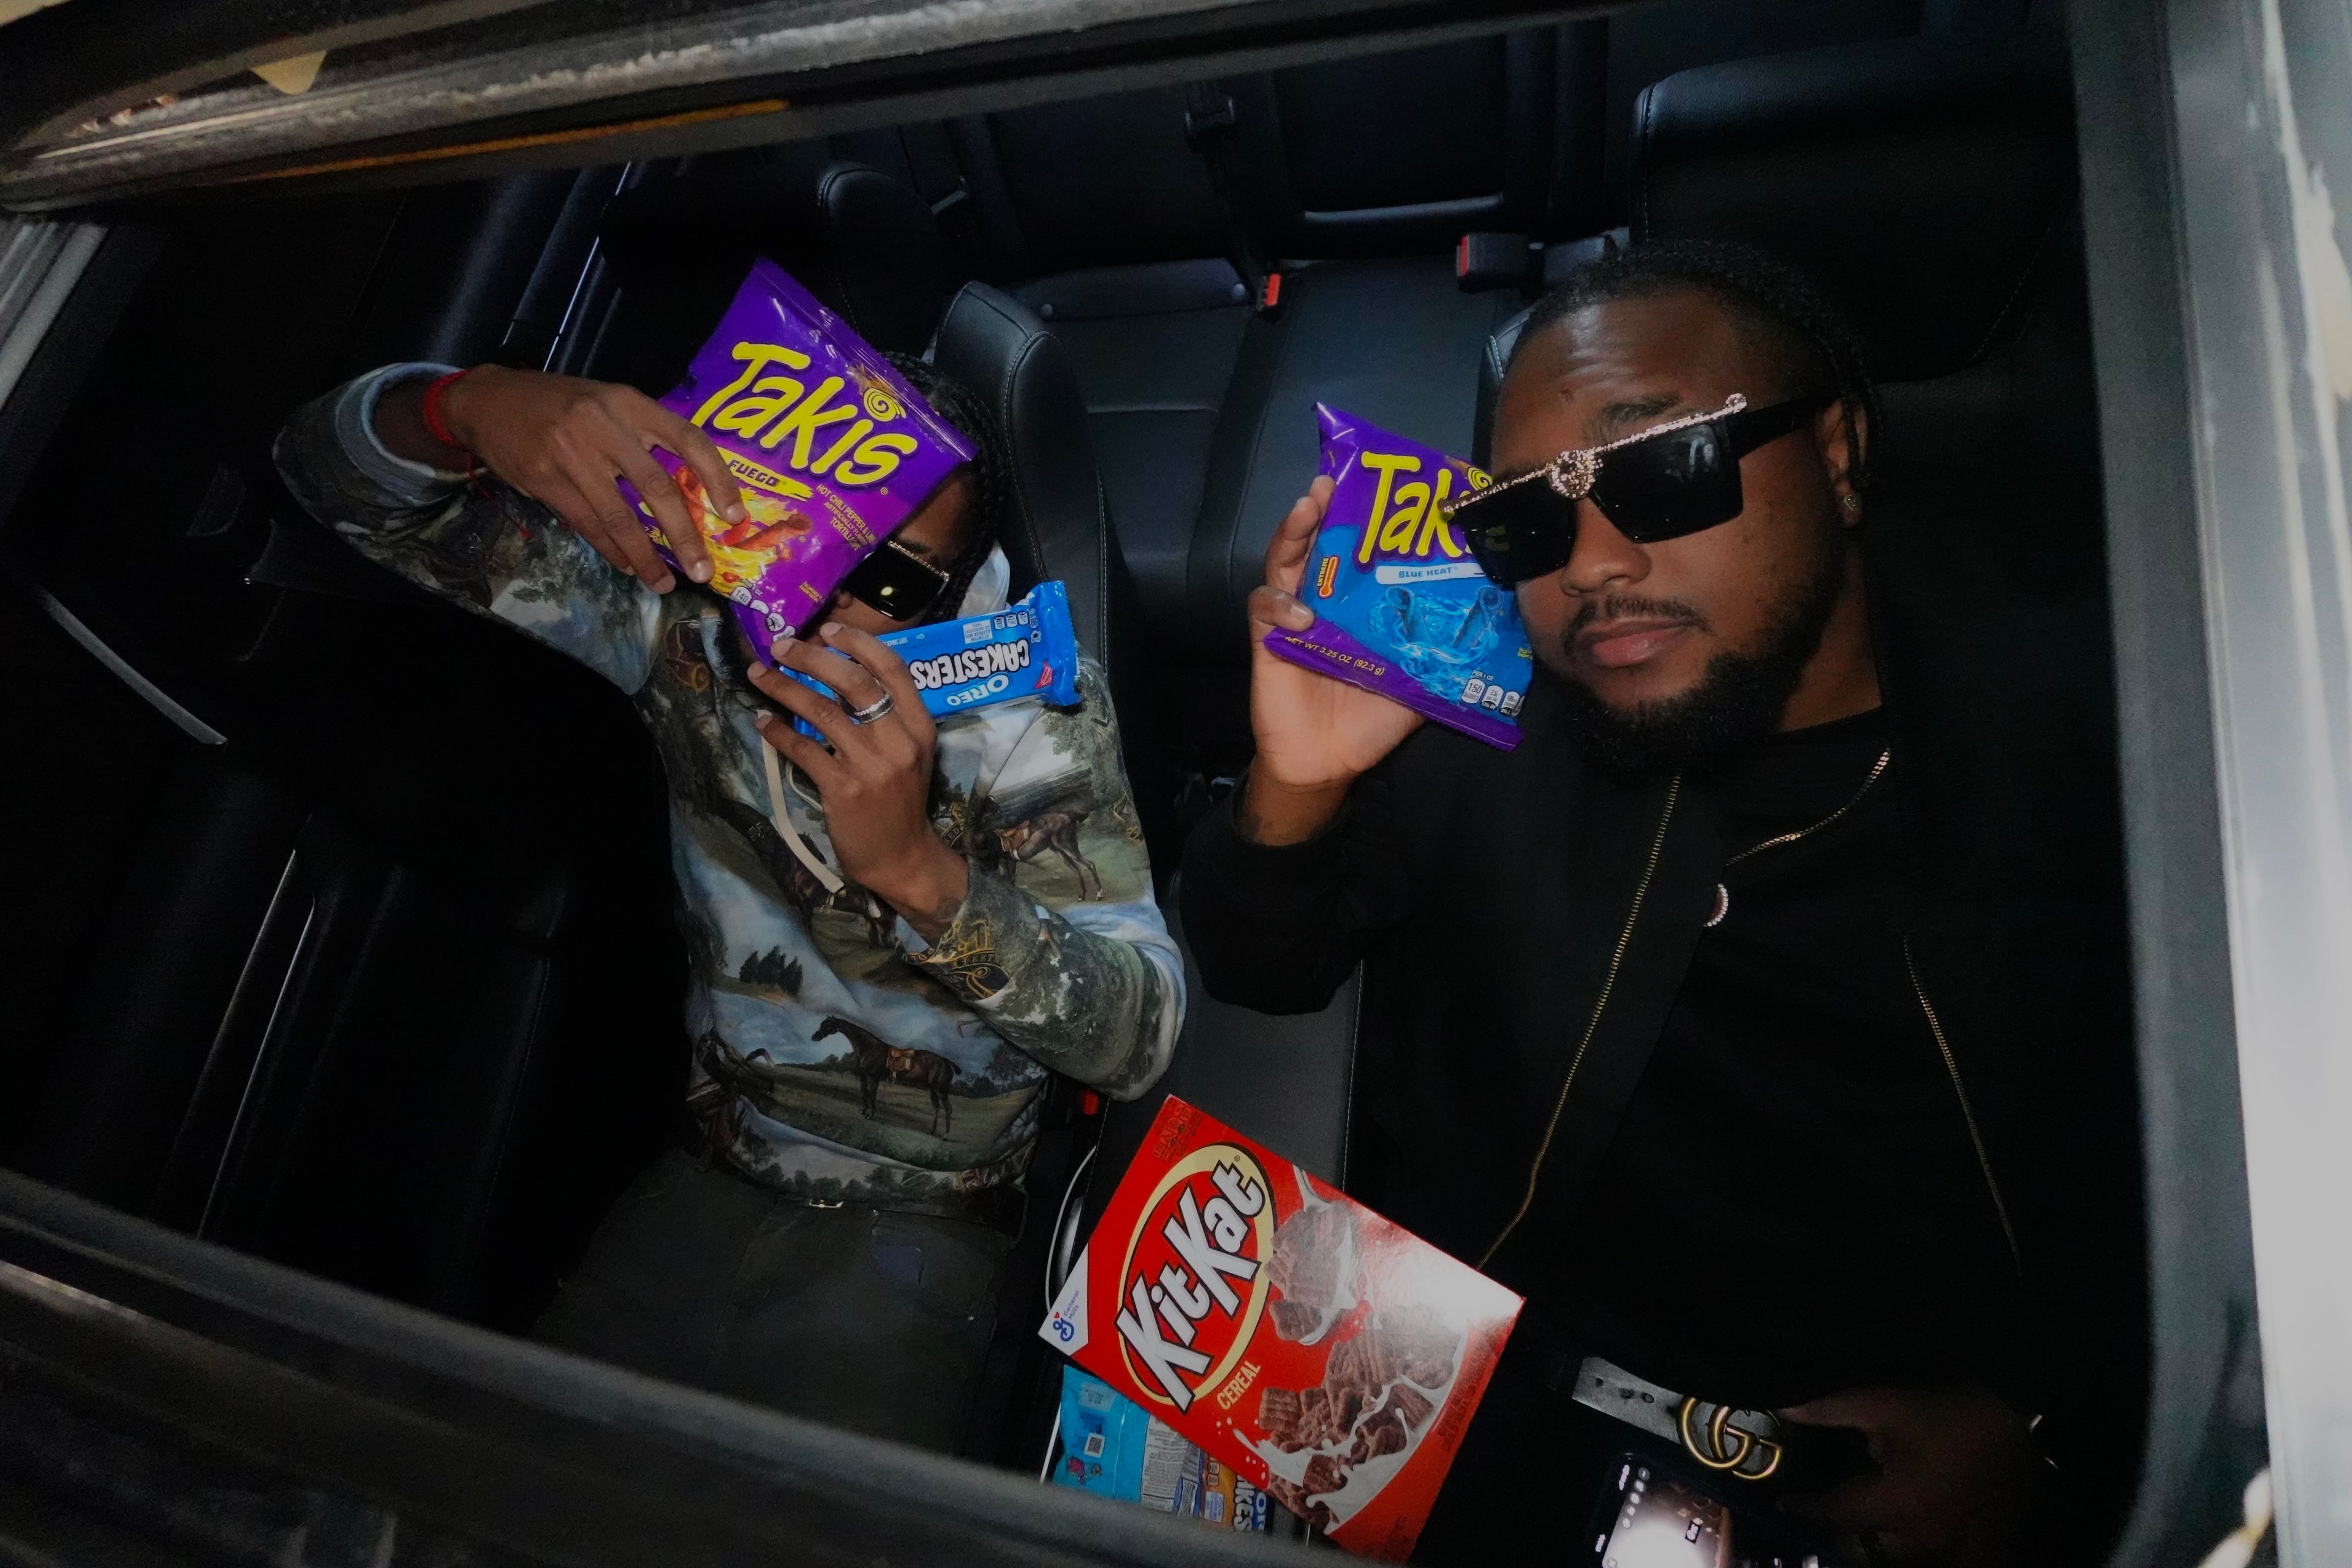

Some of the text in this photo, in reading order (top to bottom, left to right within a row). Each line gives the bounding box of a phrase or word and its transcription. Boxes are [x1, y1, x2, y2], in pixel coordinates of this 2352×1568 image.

[691, 341, 918, 485] Takis
[728, 459, 781, 486] FUEGO
[816, 483, 832, 497] HOT
[829, 494, 846, 510] CHILI
[844, 507, 865, 527] PEPPER
[1359, 451, 1472, 564] Tak
[1317, 556, 1329, 587] EXTREME
[1398, 567, 1453, 579] BLUE HEAT
[910, 639, 1030, 690] CAKESTERS
[1304, 641, 1319, 652] WT
[1319, 646, 1338, 658] 3.25
[1338, 652, 1352, 664] OZ
[1353, 657, 1375, 673] (92.3
[947, 674, 1009, 706] OREO
[1468, 682, 1482, 694] 150
[1115, 1159, 1266, 1414] KitKat
[1216, 1360, 1261, 1410] CEREAL
[1233, 1474, 1254, 1531] AKES
